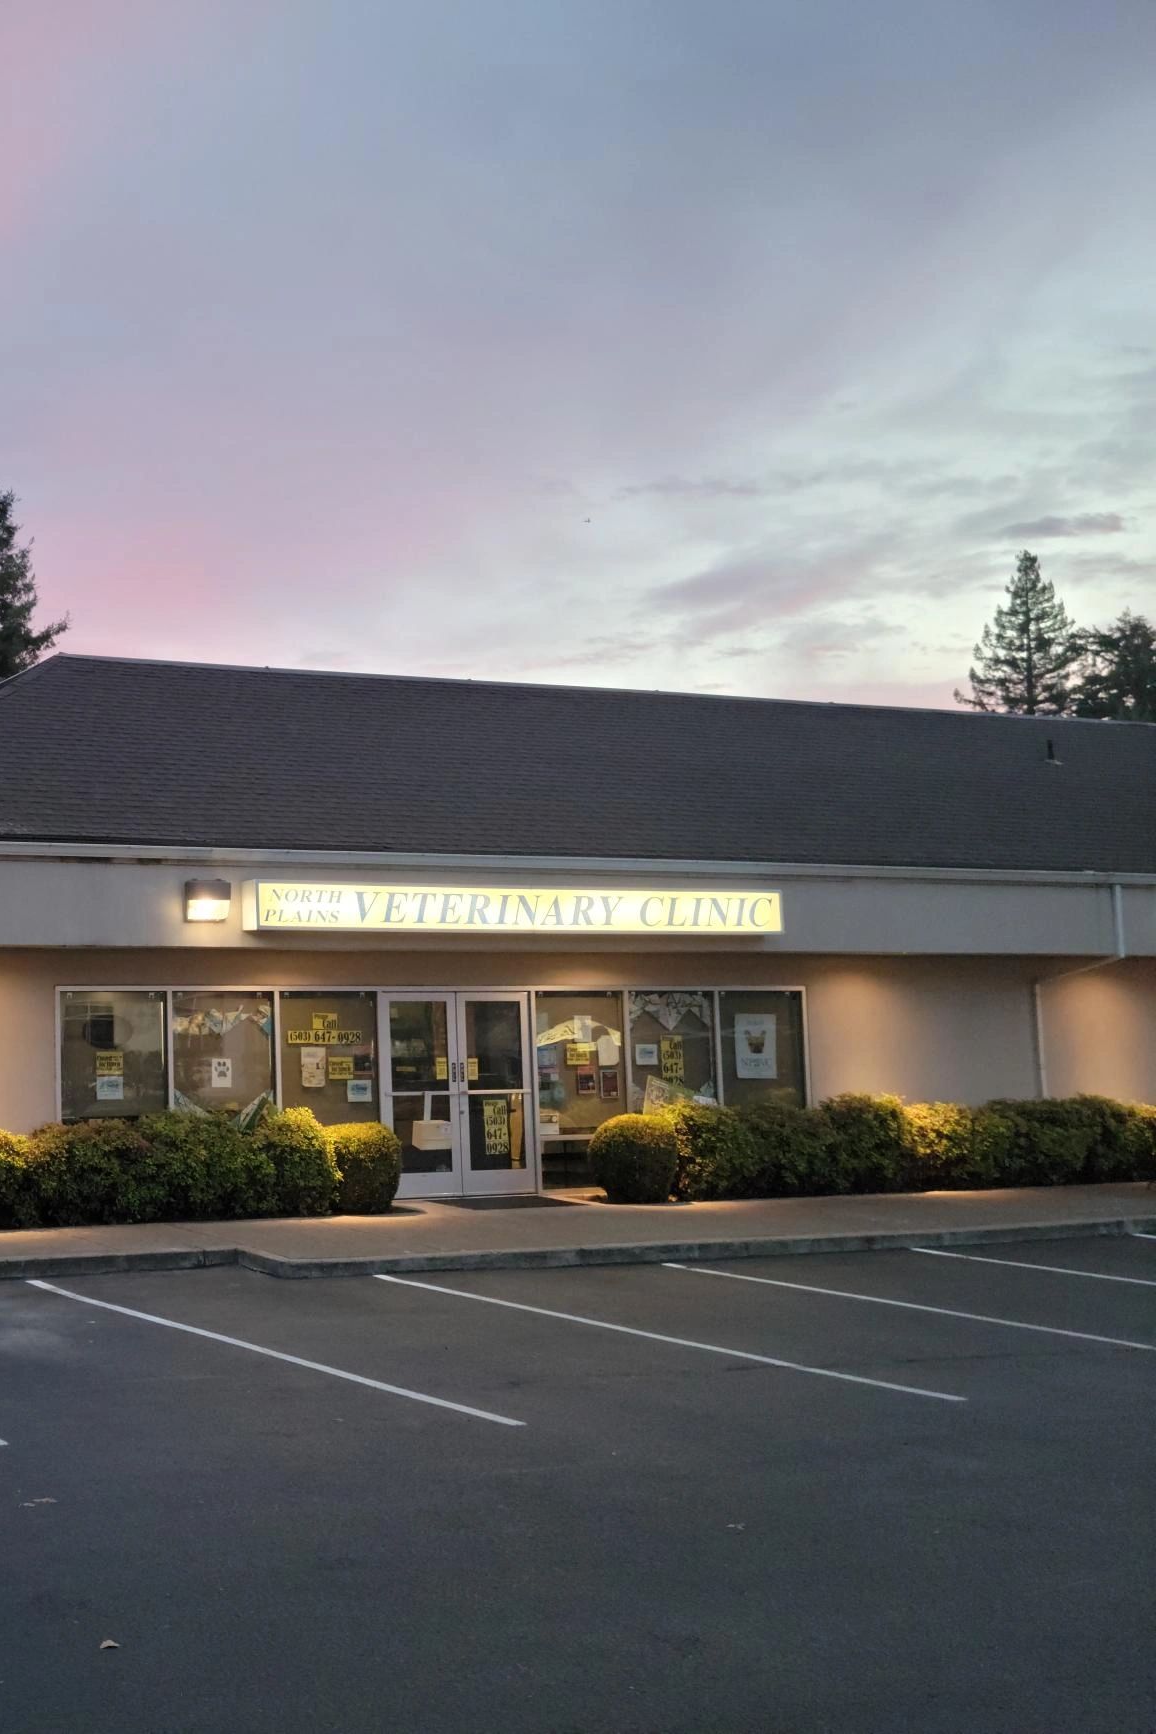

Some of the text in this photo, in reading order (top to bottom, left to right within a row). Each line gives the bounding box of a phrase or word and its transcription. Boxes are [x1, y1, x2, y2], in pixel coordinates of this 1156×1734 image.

[268, 888, 342, 903] NORTH
[354, 891, 772, 927] VETERINARY CLINIC
[264, 909, 340, 923] PLAINS
[322, 1019, 337, 1029] Call
[289, 1031, 311, 1042] (503)
[486, 1142, 509, 1154] 0928
